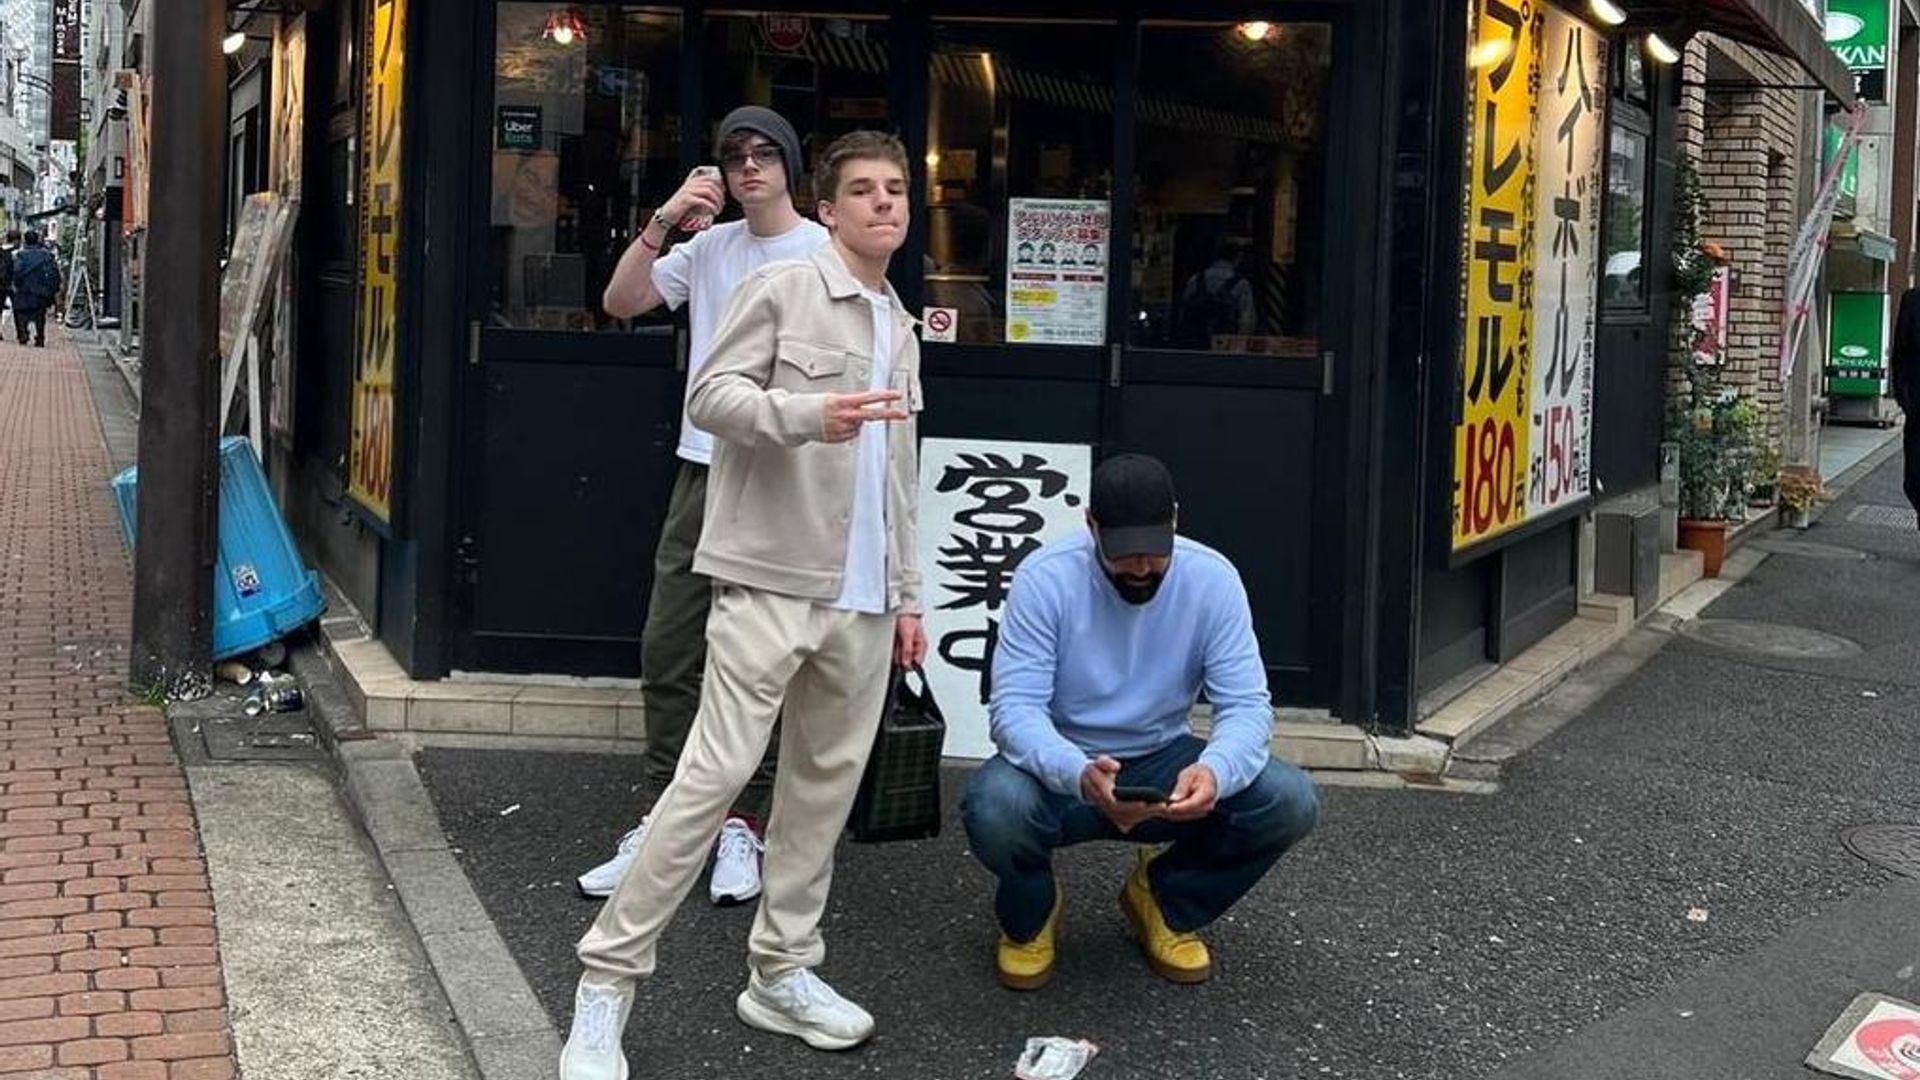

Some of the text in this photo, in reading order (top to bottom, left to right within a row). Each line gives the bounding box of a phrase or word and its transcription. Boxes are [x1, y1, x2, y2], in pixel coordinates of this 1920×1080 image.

[1831, 44, 1886, 66] KAN
[505, 119, 533, 132] Uber
[1467, 0, 1529, 405] プレモル
[1544, 27, 1592, 398] ハイボール
[361, 384, 389, 502] 180
[1462, 416, 1515, 534] 180
[1541, 405, 1574, 504] 150
[934, 453, 1081, 705] 営業中
